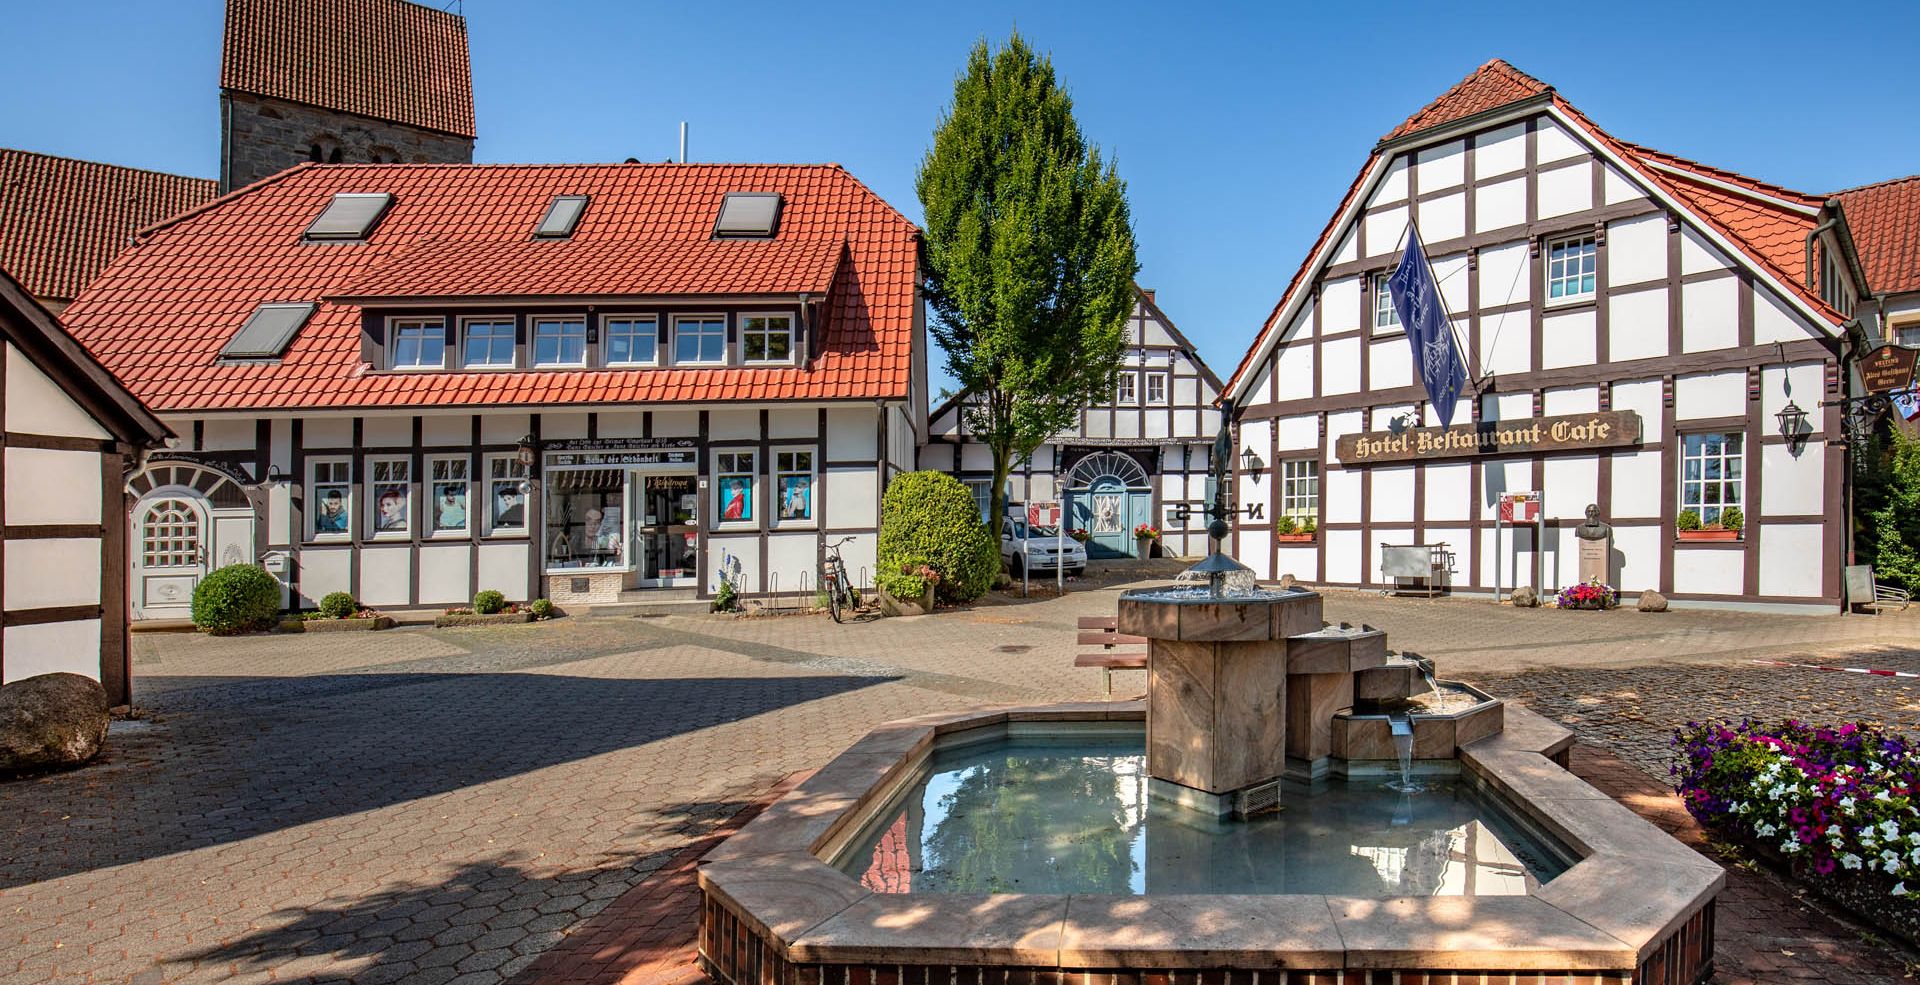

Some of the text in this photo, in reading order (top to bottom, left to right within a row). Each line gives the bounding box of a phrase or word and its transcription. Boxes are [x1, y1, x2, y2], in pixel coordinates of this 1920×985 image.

[1355, 418, 1611, 459] Hotel Restaurant Cafe
[607, 454, 620, 464] der
[622, 453, 659, 464] Schönheit
